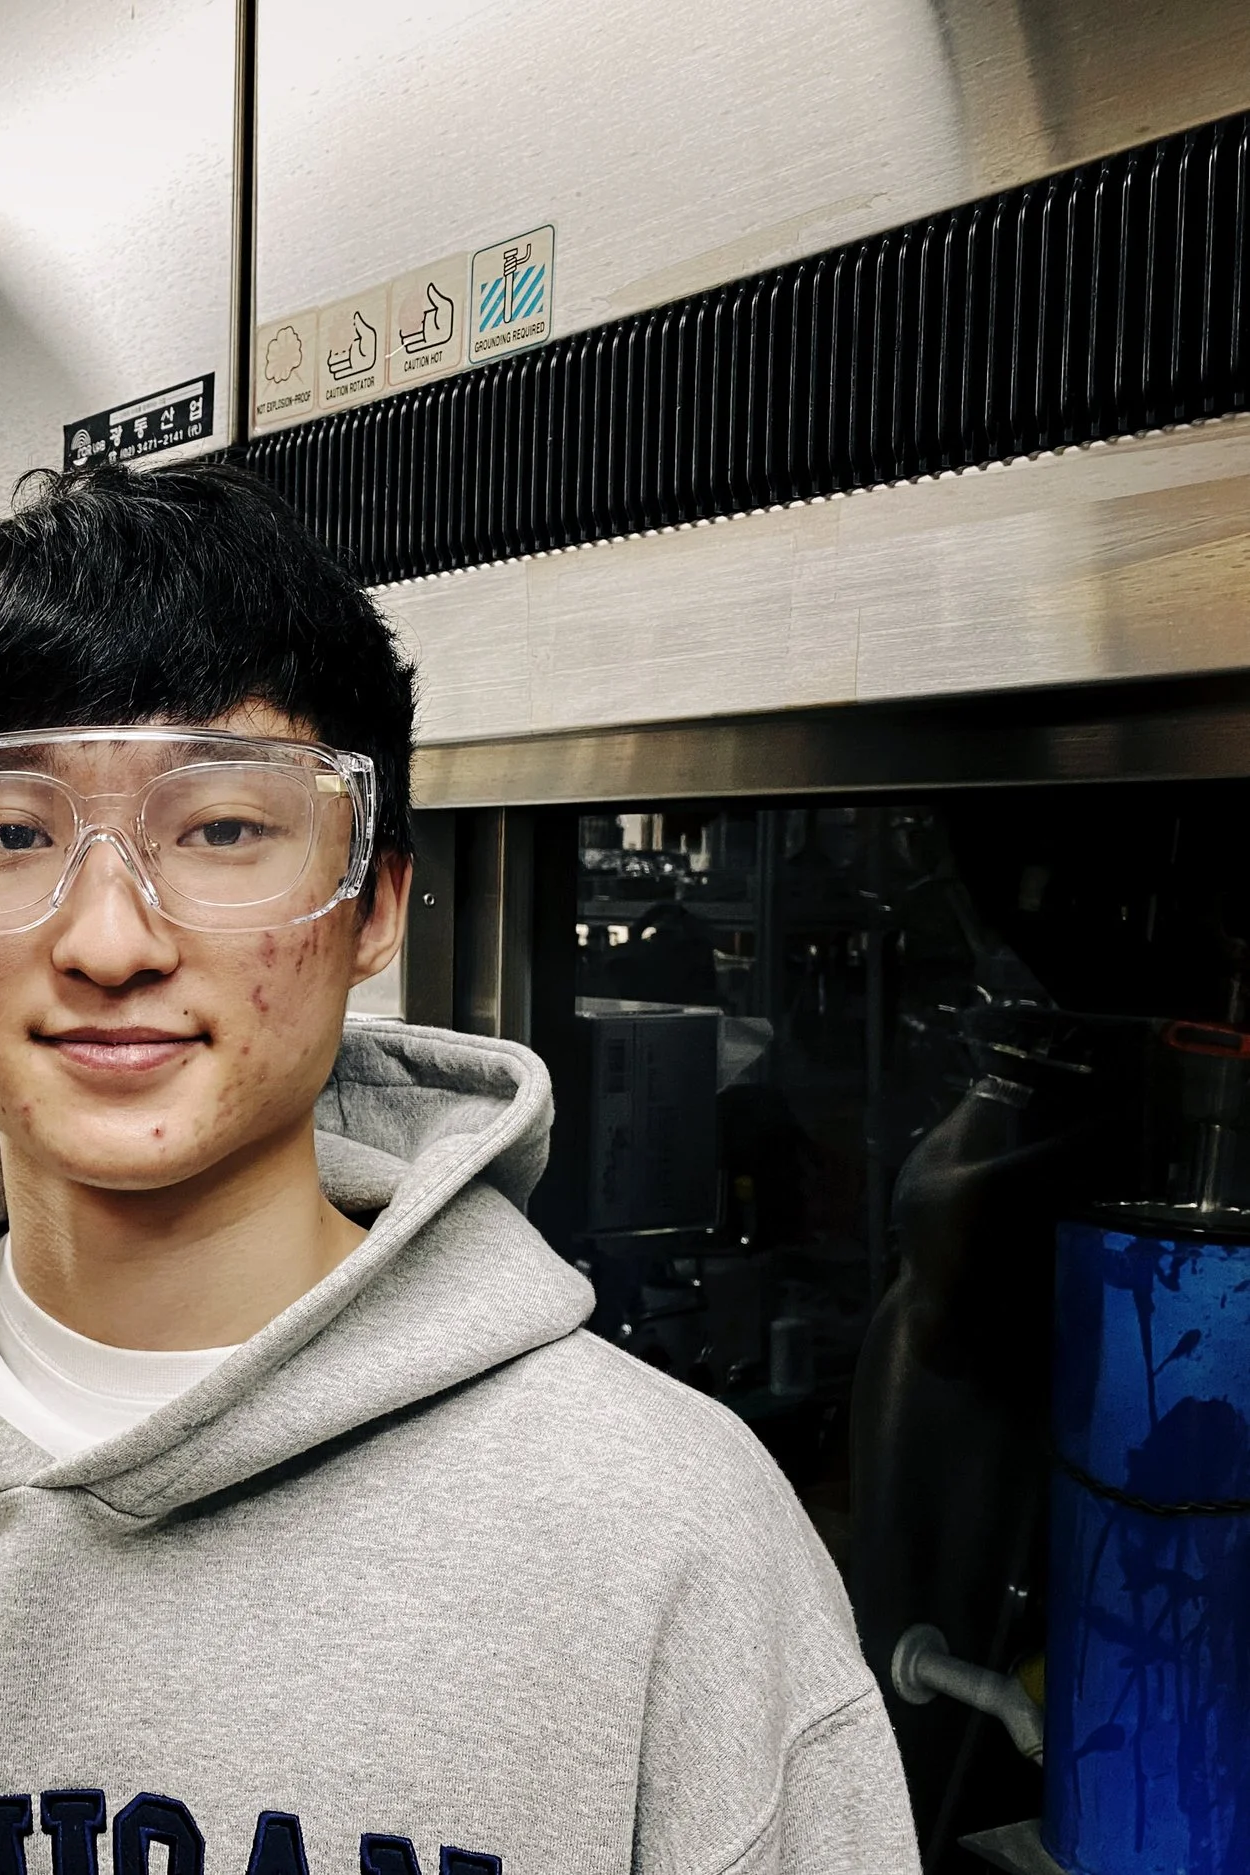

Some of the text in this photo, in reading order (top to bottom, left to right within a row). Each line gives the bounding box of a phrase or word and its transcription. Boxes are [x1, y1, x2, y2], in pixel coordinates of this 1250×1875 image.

[474, 321, 545, 353] GROUNDING REQUIRED
[404, 351, 443, 372] CAUTION HOT
[325, 376, 375, 400] CAUTION ROTATOR
[266, 390, 312, 413] EXPLOSION-PROOF
[136, 429, 184, 454] 3471-2141
